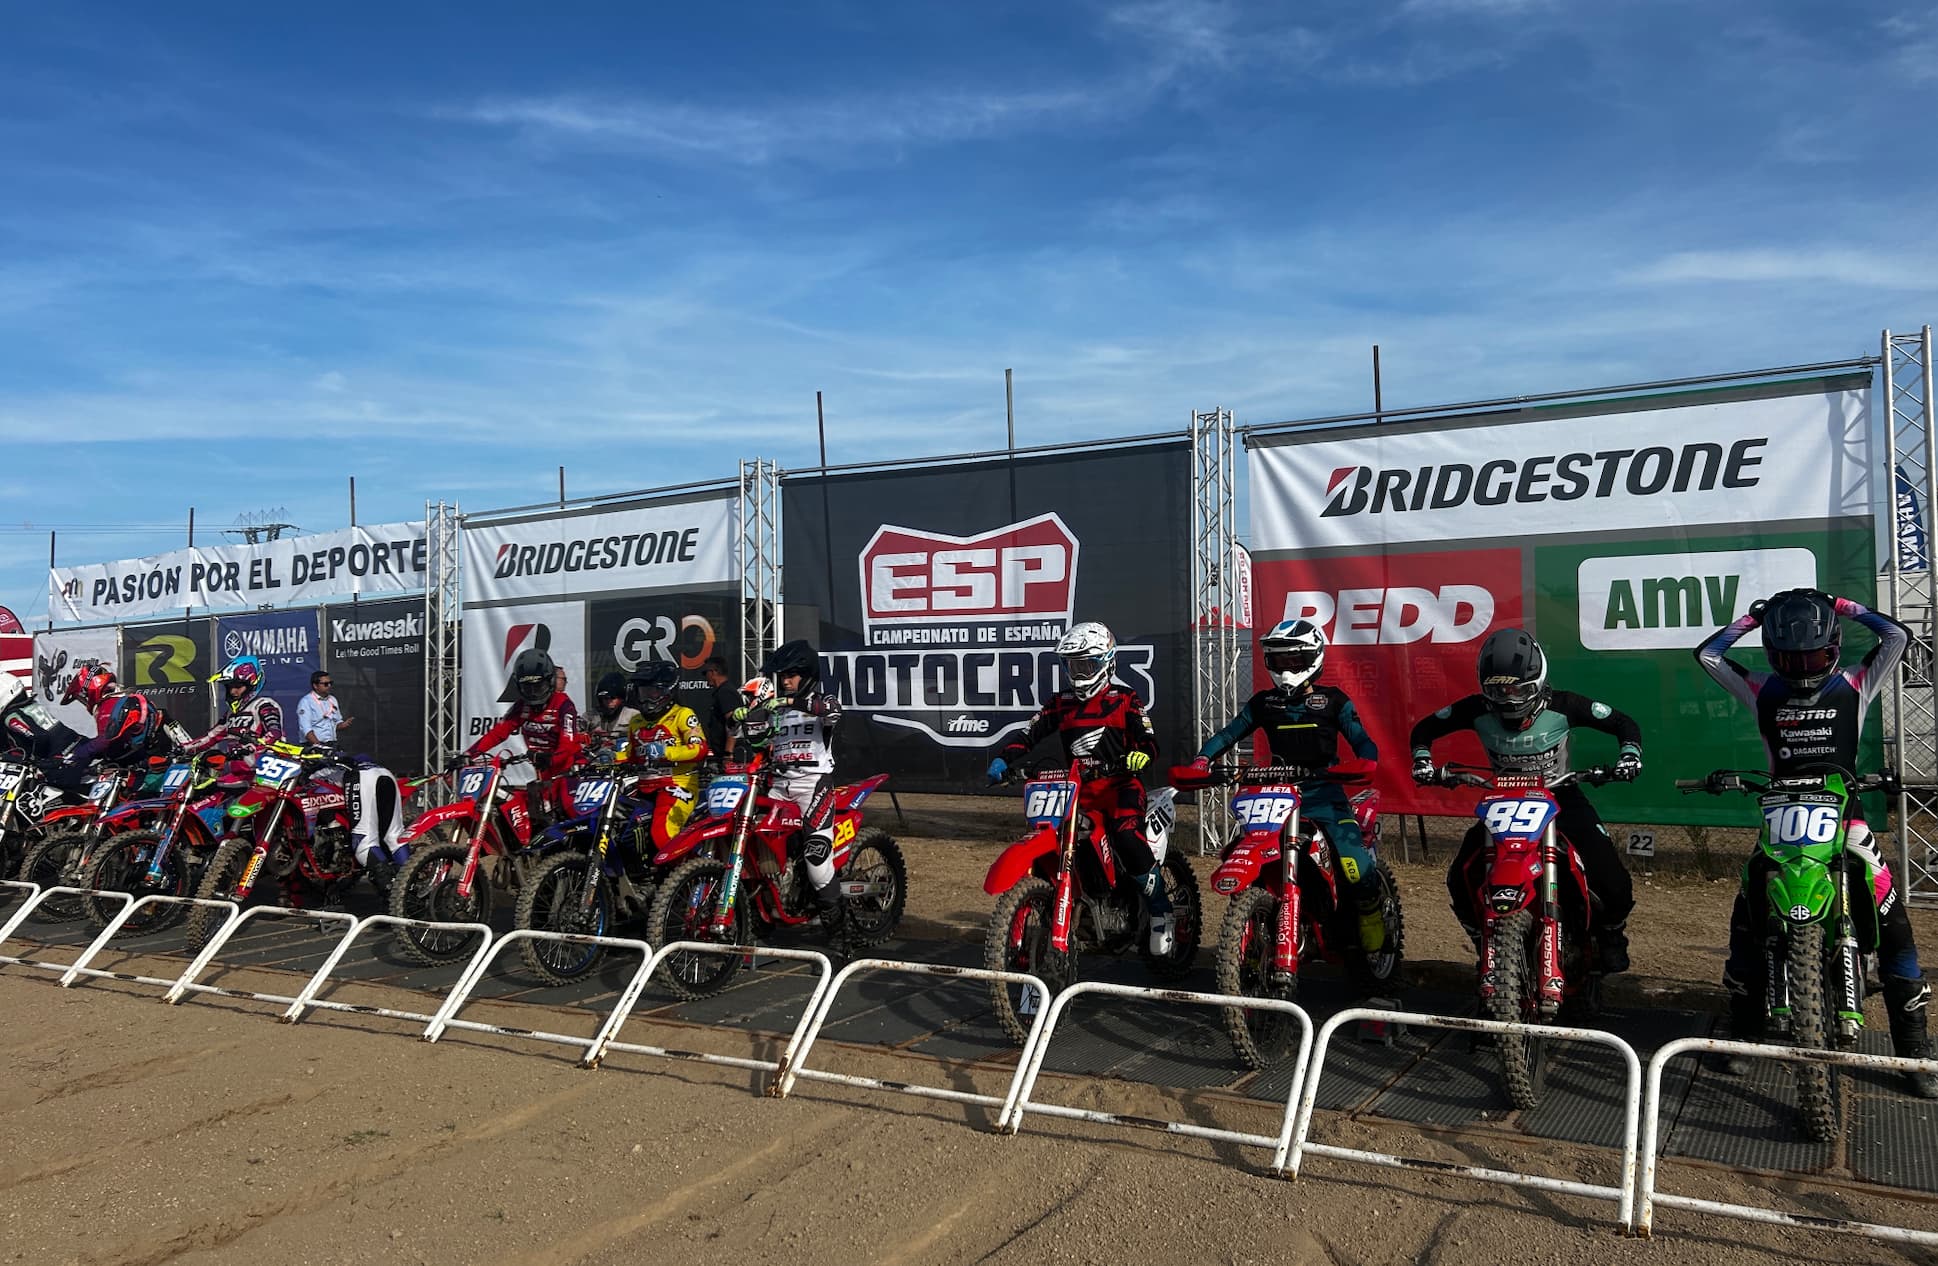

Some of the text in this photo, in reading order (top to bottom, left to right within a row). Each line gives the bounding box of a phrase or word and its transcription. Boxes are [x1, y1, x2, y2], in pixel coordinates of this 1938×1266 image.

[1320, 437, 1767, 518] BRIDGESTONE
[494, 527, 700, 579] BRIDGESTONE
[92, 538, 427, 606] PASIÓN POR EL DEPORTE
[871, 544, 1067, 612] ESP
[332, 613, 425, 643] Kawasaki
[1282, 584, 1495, 646] REDD
[242, 626, 309, 656] YAMAHA
[613, 614, 716, 673] GRO
[873, 621, 1062, 644] CAMPEONATO DE ESPAÑA
[360, 646, 380, 657] Good
[380, 644, 403, 655] Times
[404, 643, 420, 654] Roll
[135, 686, 196, 697] GRAPHICS
[819, 650, 1150, 706] MOTOCROS
[948, 716, 989, 732] rfme
[1780, 727, 1832, 738] Kawasaki
[256, 756, 300, 779] 357
[777, 752, 813, 762] ASGAS
[164, 769, 189, 786] 11
[460, 773, 484, 794] 18
[574, 782, 609, 803] 914
[1149, 808, 1172, 835] 611
[1236, 798, 1294, 825] 398
[1484, 801, 1549, 834] 89
[1765, 806, 1838, 844] 106
[1629, 834, 1653, 851] 22
[1543, 926, 1552, 977] GASGAS
[1843, 946, 1856, 1011] DUNLOP
